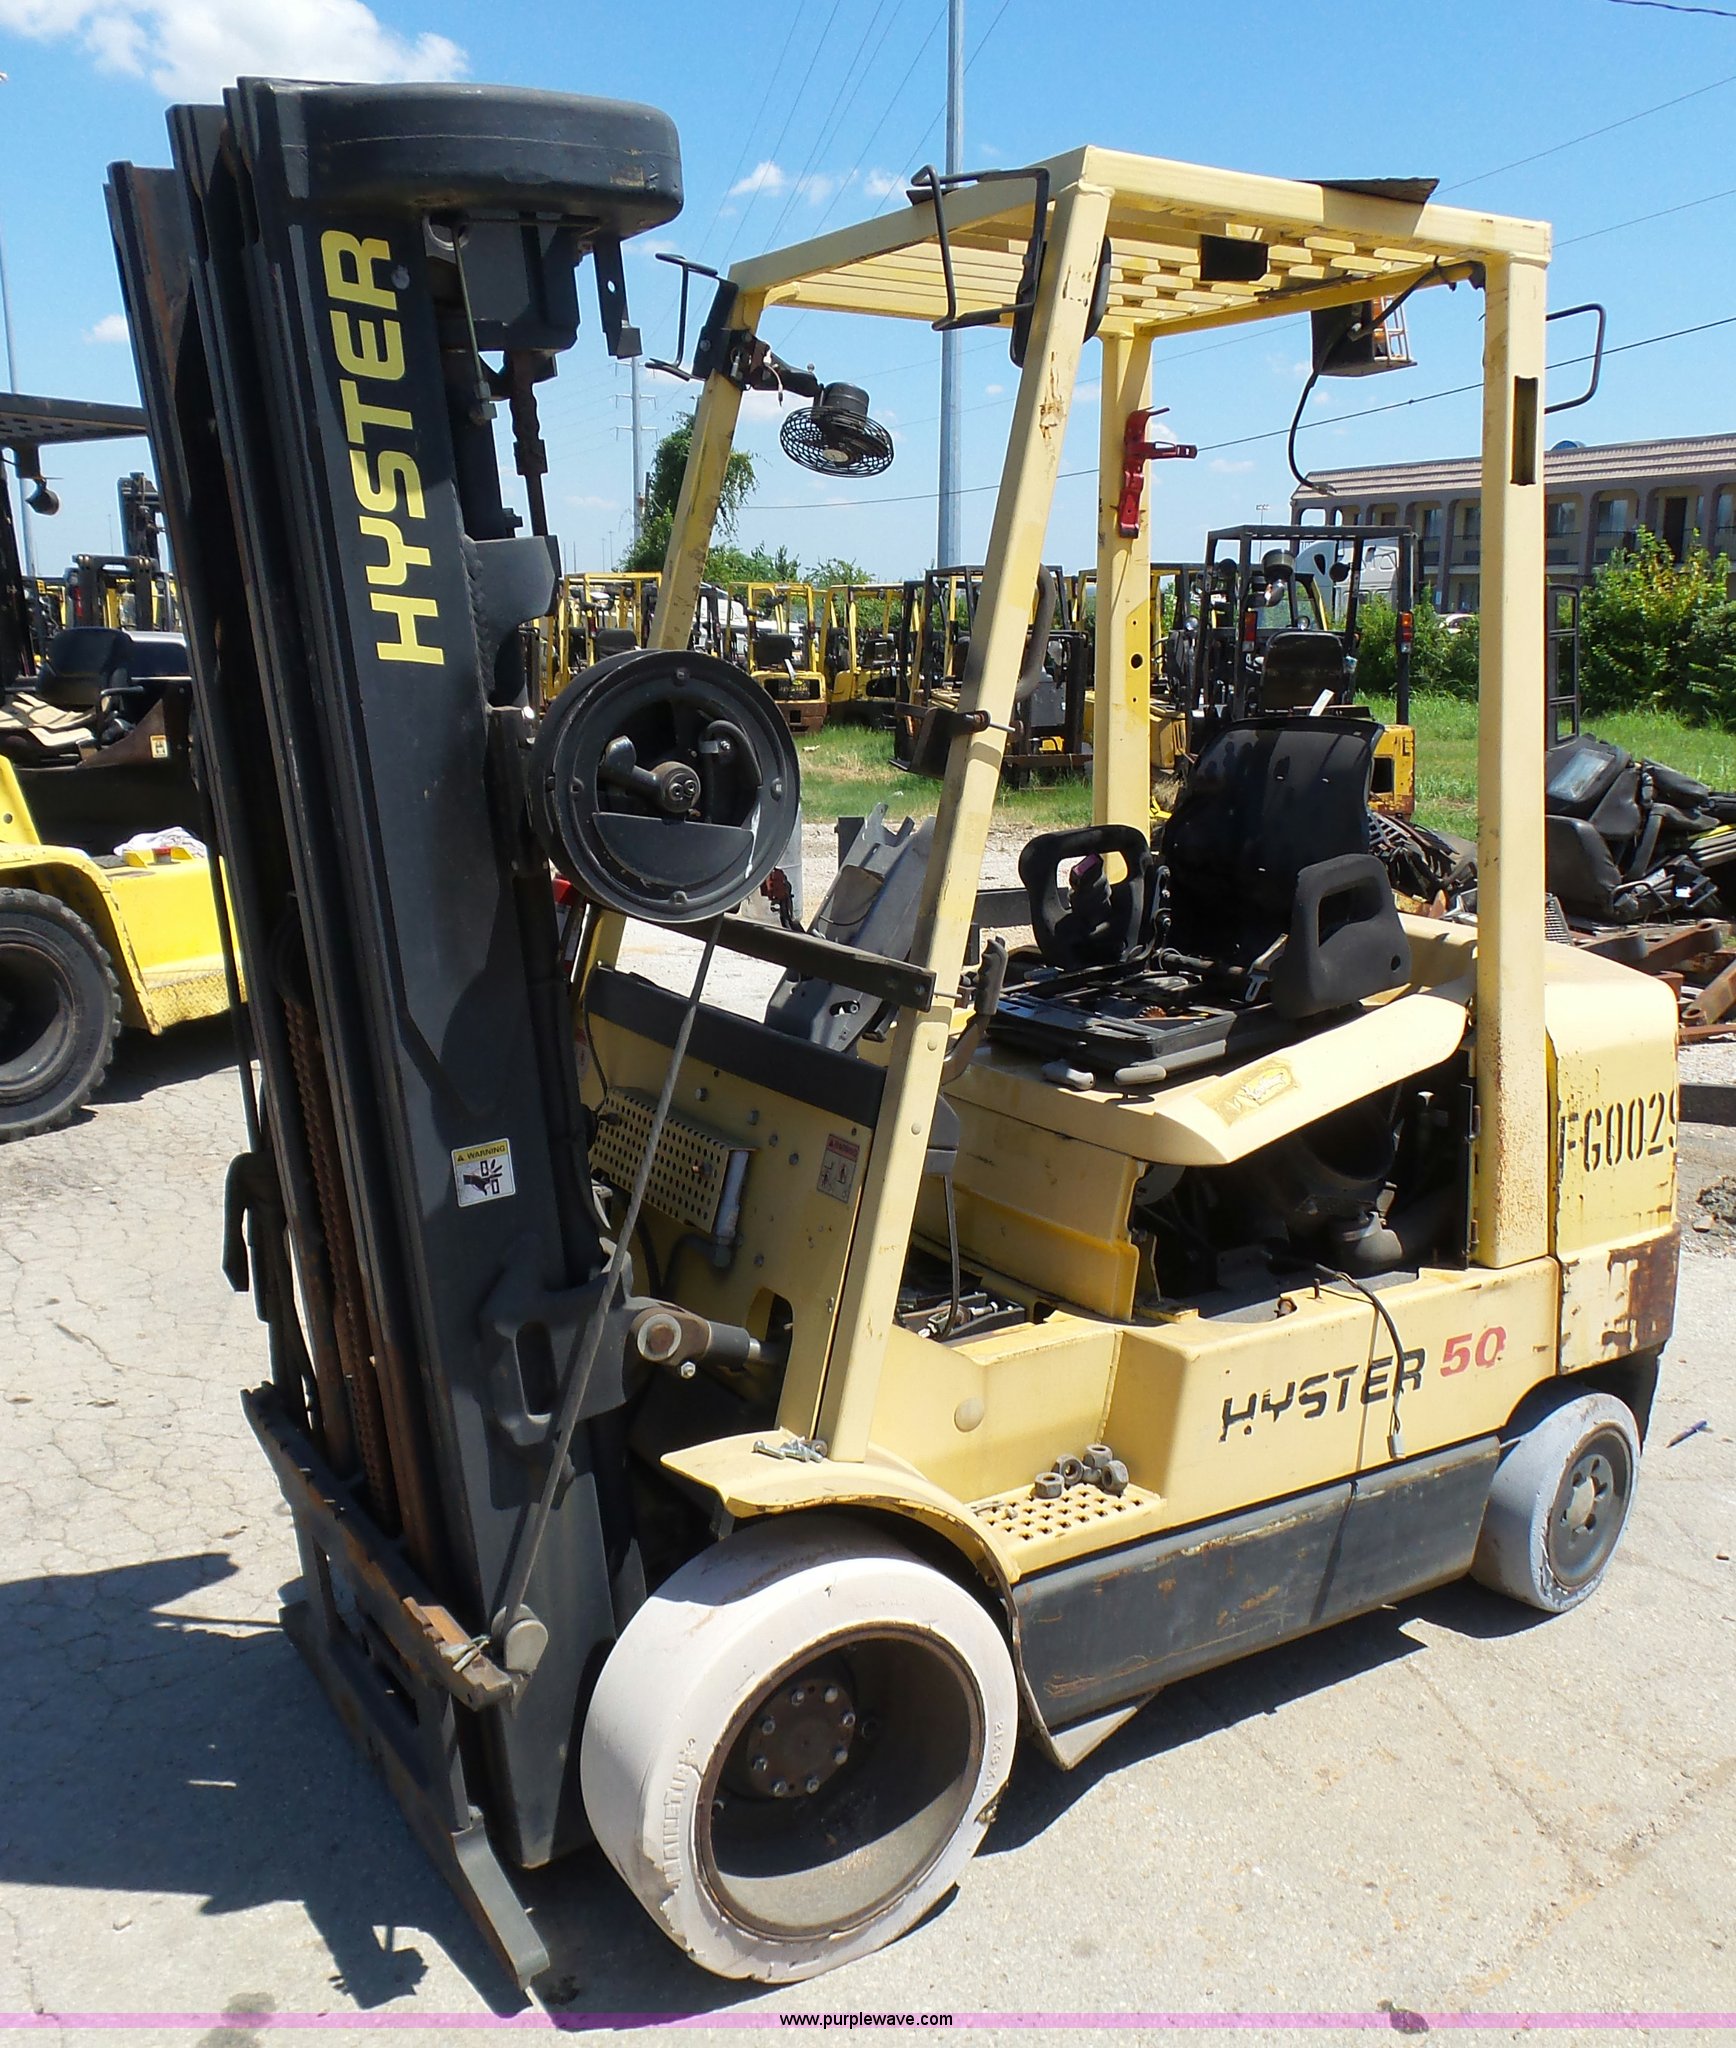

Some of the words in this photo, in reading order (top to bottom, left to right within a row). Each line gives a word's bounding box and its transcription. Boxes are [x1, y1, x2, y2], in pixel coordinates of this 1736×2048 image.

[320, 230, 445, 666] HYSTER
[466, 1144, 506, 1160] WARNING
[1218, 1348, 1426, 1443] HYSTER
[1440, 1326, 1507, 1377] 50
